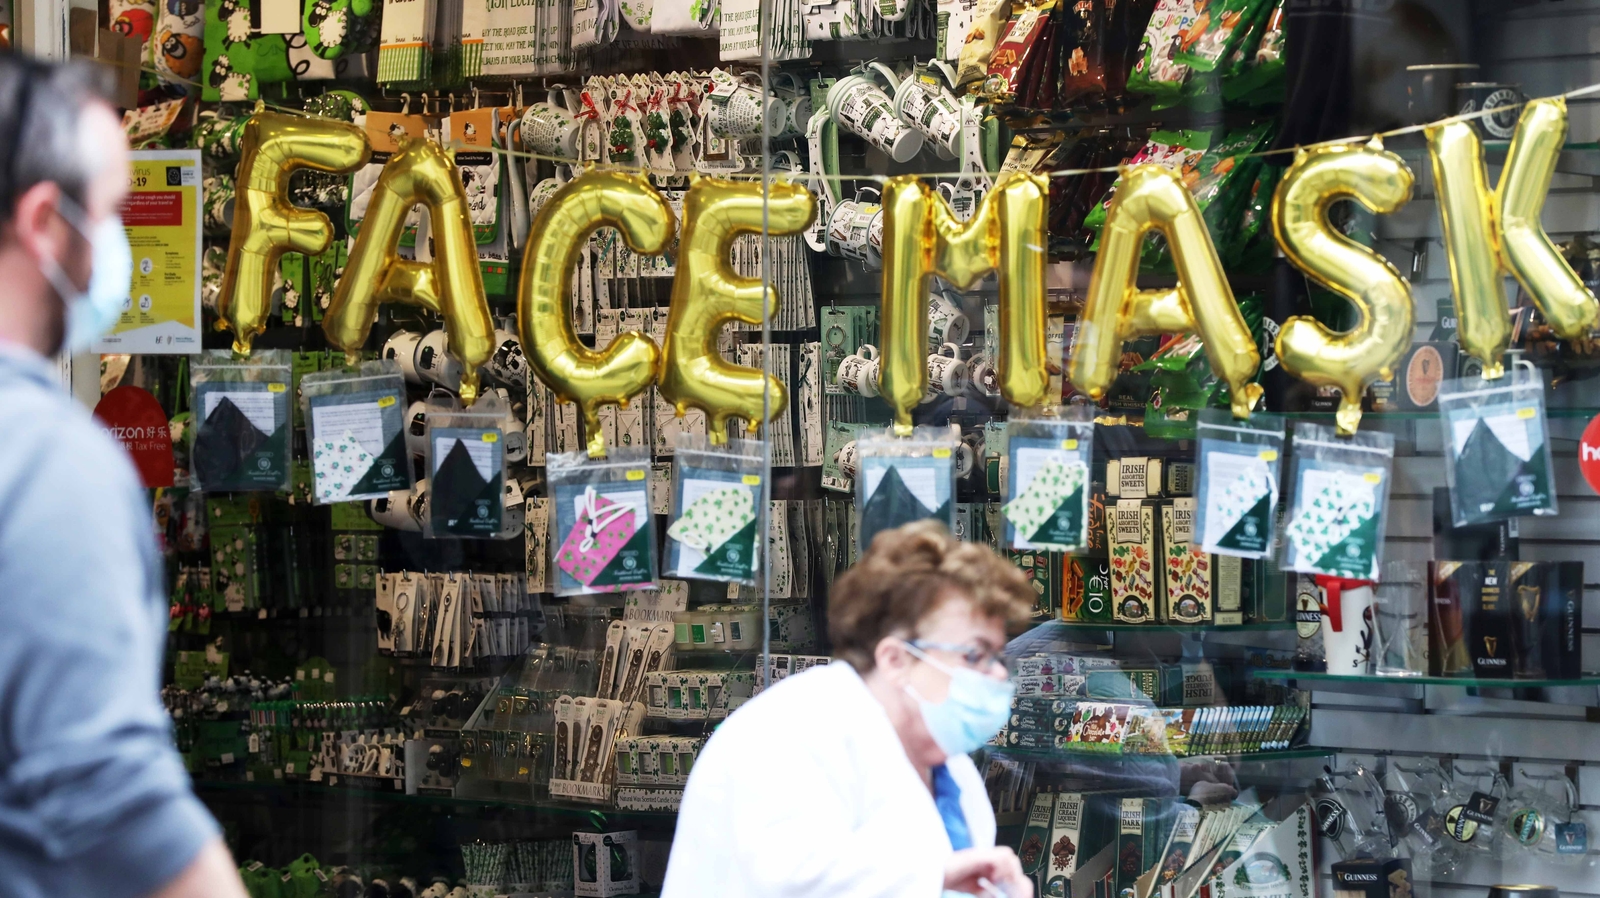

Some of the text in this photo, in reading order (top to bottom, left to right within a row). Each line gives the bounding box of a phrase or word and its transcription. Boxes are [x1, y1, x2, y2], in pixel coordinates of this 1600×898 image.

[482, 57, 500, 66] LWAYS
[216, 97, 1599, 422] FACE MASK
[101, 422, 144, 439] orizon
[135, 441, 166, 451] Tax Free
[1121, 464, 1145, 474] IRISH
[1118, 510, 1139, 520] IRISH
[1175, 510, 1191, 519] IRIS
[1118, 526, 1140, 534] SWEETS
[1175, 526, 1190, 534] SWEE
[1484, 577, 1498, 585] NEW
[1477, 657, 1507, 666] GUINNESS
[1185, 674, 1213, 683] FUDGE
[1185, 688, 1212, 698] IRISH
[1033, 805, 1052, 813] IRISH
[1060, 801, 1079, 810] IRISH
[1121, 811, 1141, 819] IRISH
[1344, 873, 1378, 881] GUINNESS
